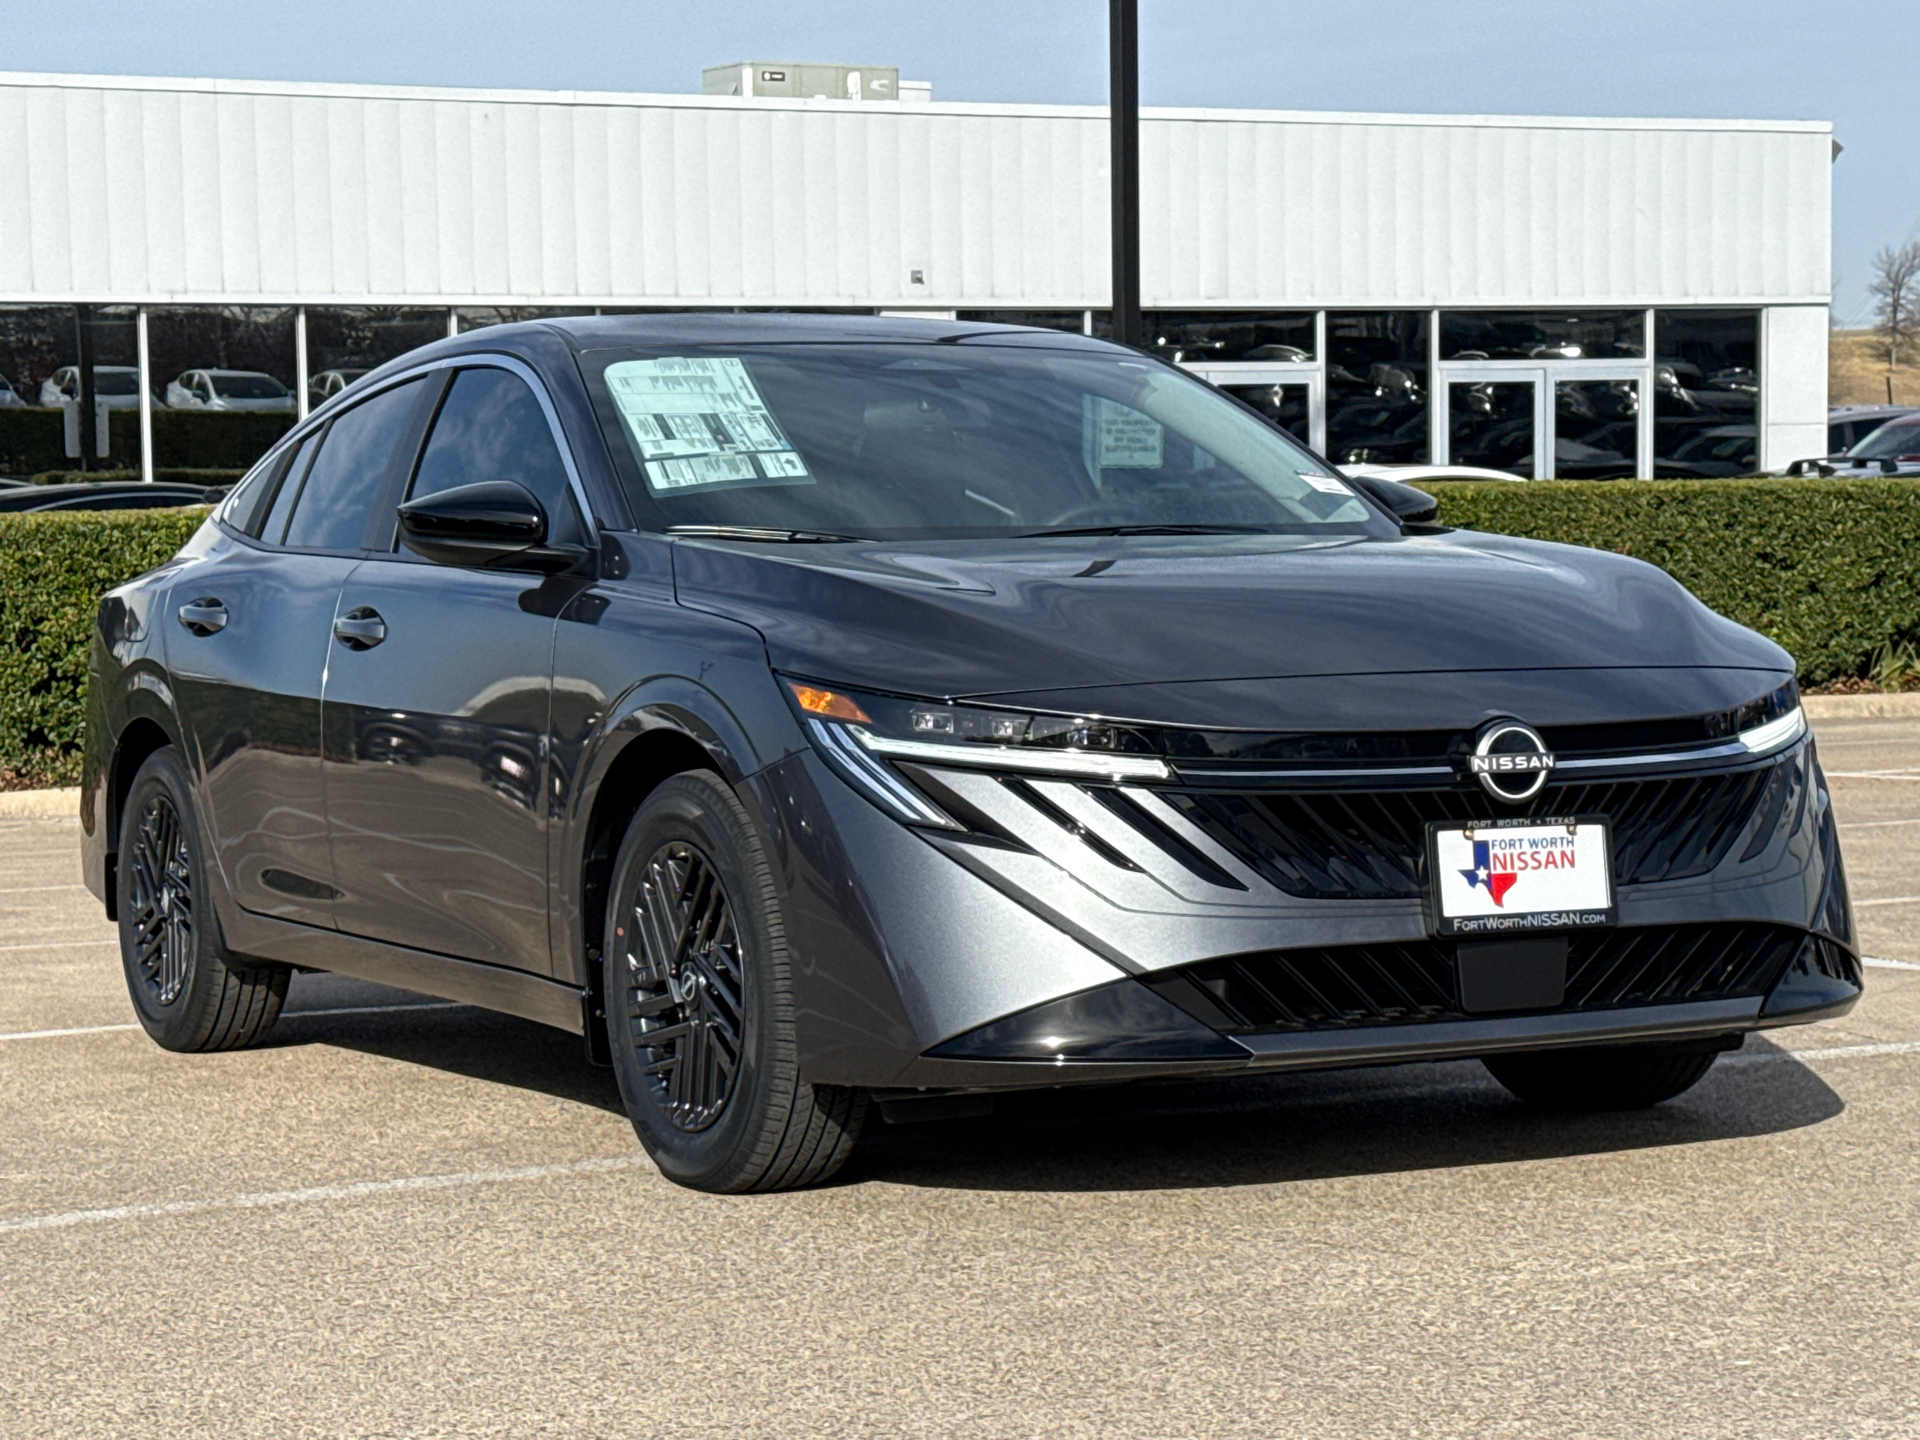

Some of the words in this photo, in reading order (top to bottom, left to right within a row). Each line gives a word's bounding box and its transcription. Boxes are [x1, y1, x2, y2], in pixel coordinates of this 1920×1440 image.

[1474, 756, 1554, 771] NISSAN
[1467, 820, 1492, 829] FORT
[1496, 818, 1531, 827] WORTH
[1545, 816, 1576, 825] TEXAS
[1491, 839, 1524, 850] FORT
[1528, 837, 1575, 849] WORTH
[1493, 850, 1575, 871] NISSAN
